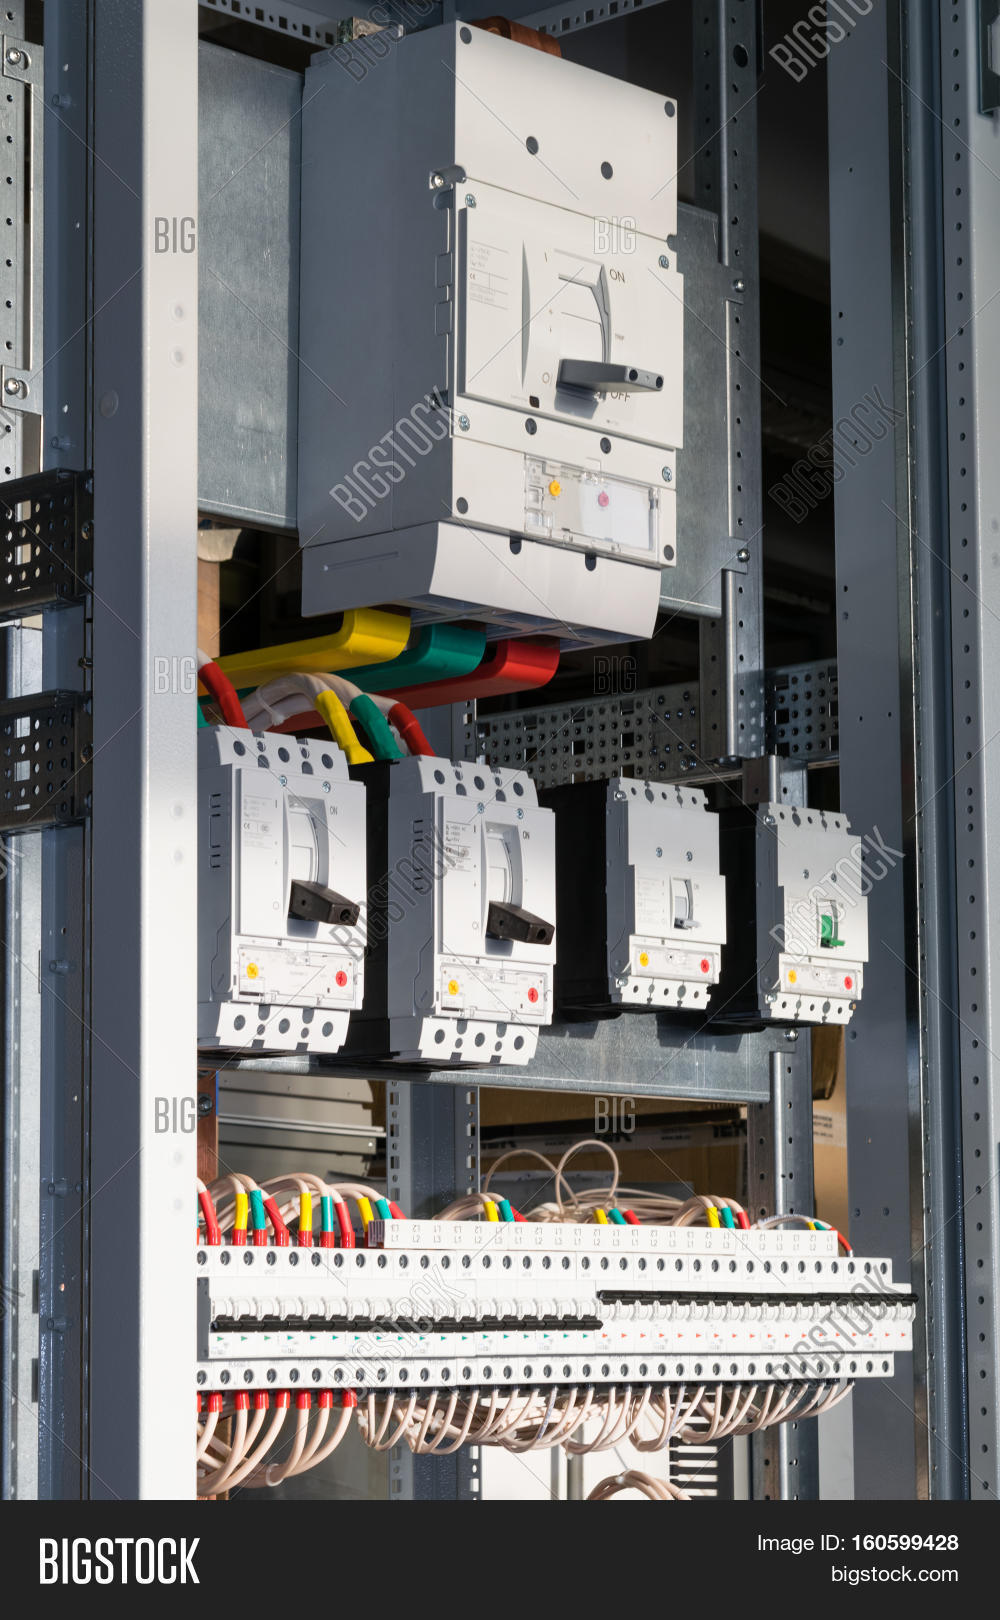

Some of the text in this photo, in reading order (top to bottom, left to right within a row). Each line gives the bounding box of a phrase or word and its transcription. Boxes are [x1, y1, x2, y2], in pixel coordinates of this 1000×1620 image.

[609, 267, 626, 284] ON
[329, 805, 338, 816] ON
[522, 830, 531, 840] ON
